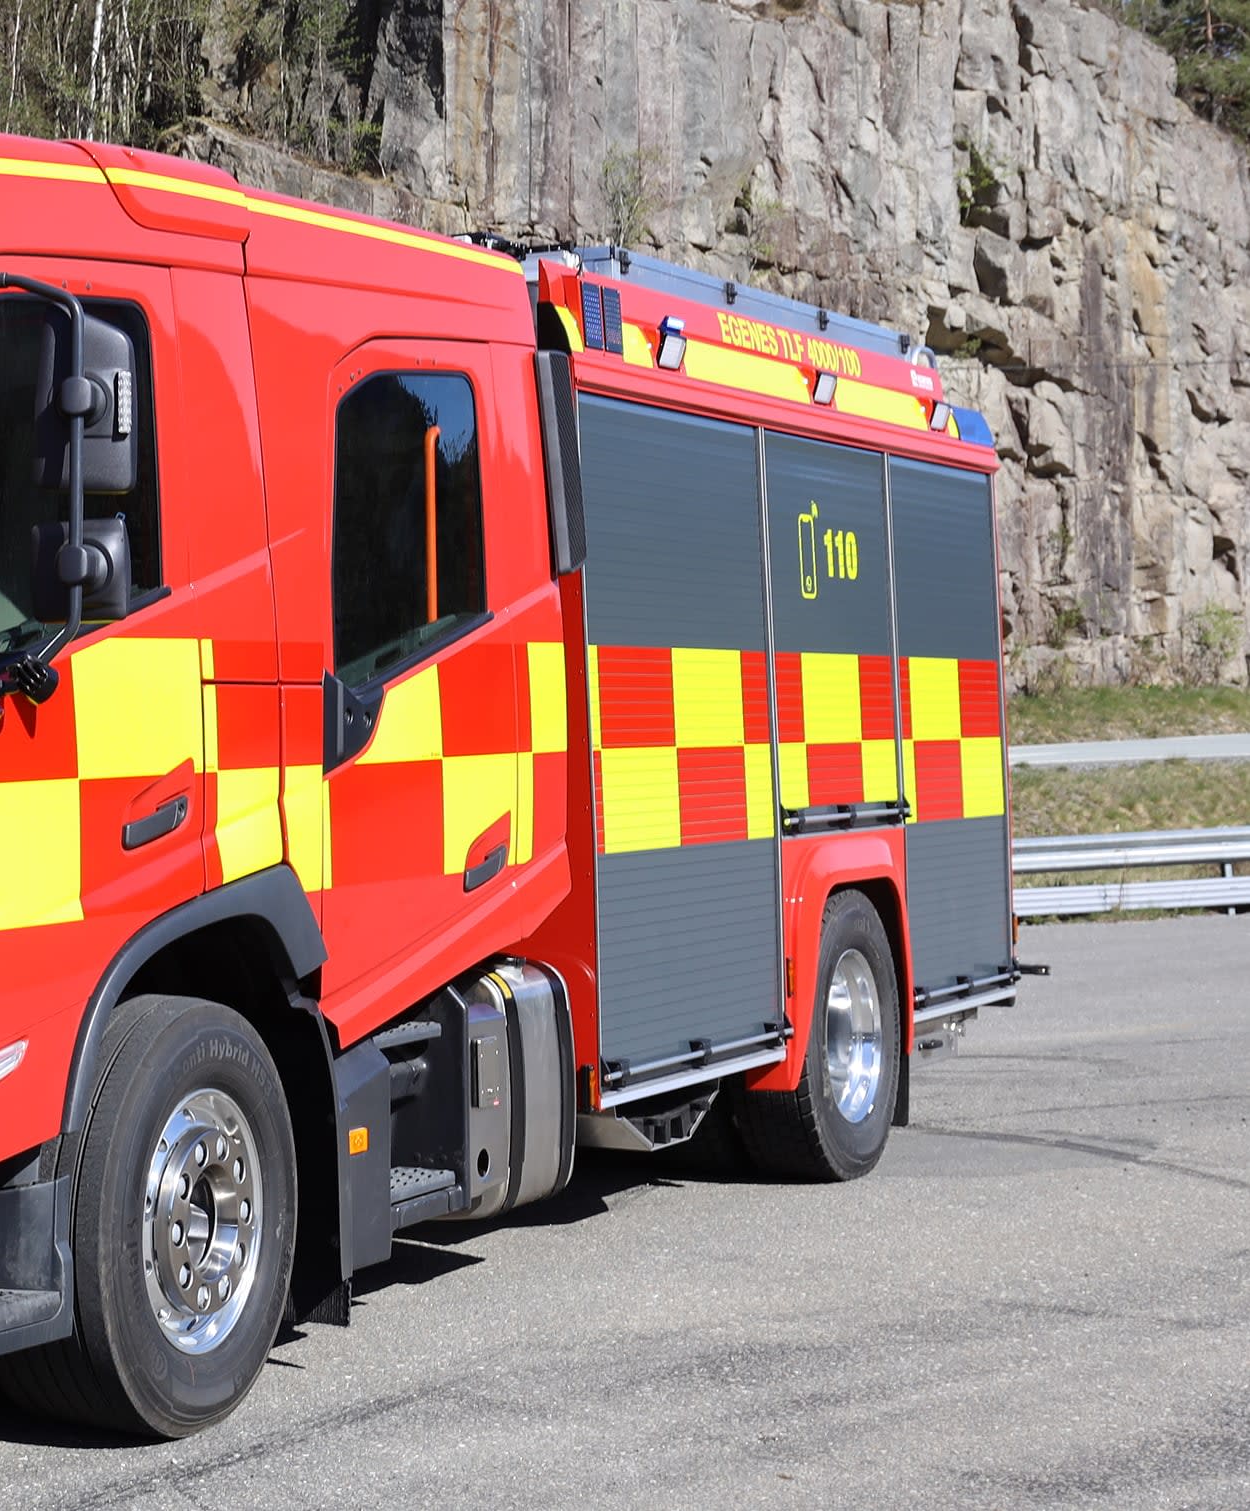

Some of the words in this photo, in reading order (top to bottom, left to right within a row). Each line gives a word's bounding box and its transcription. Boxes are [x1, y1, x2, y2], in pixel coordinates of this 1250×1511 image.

[717, 312, 779, 355] EGENES
[777, 329, 804, 363] TLF
[807, 338, 862, 377] 4000/100
[824, 529, 858, 580] 110
[210, 1038, 250, 1068] Hybrid
